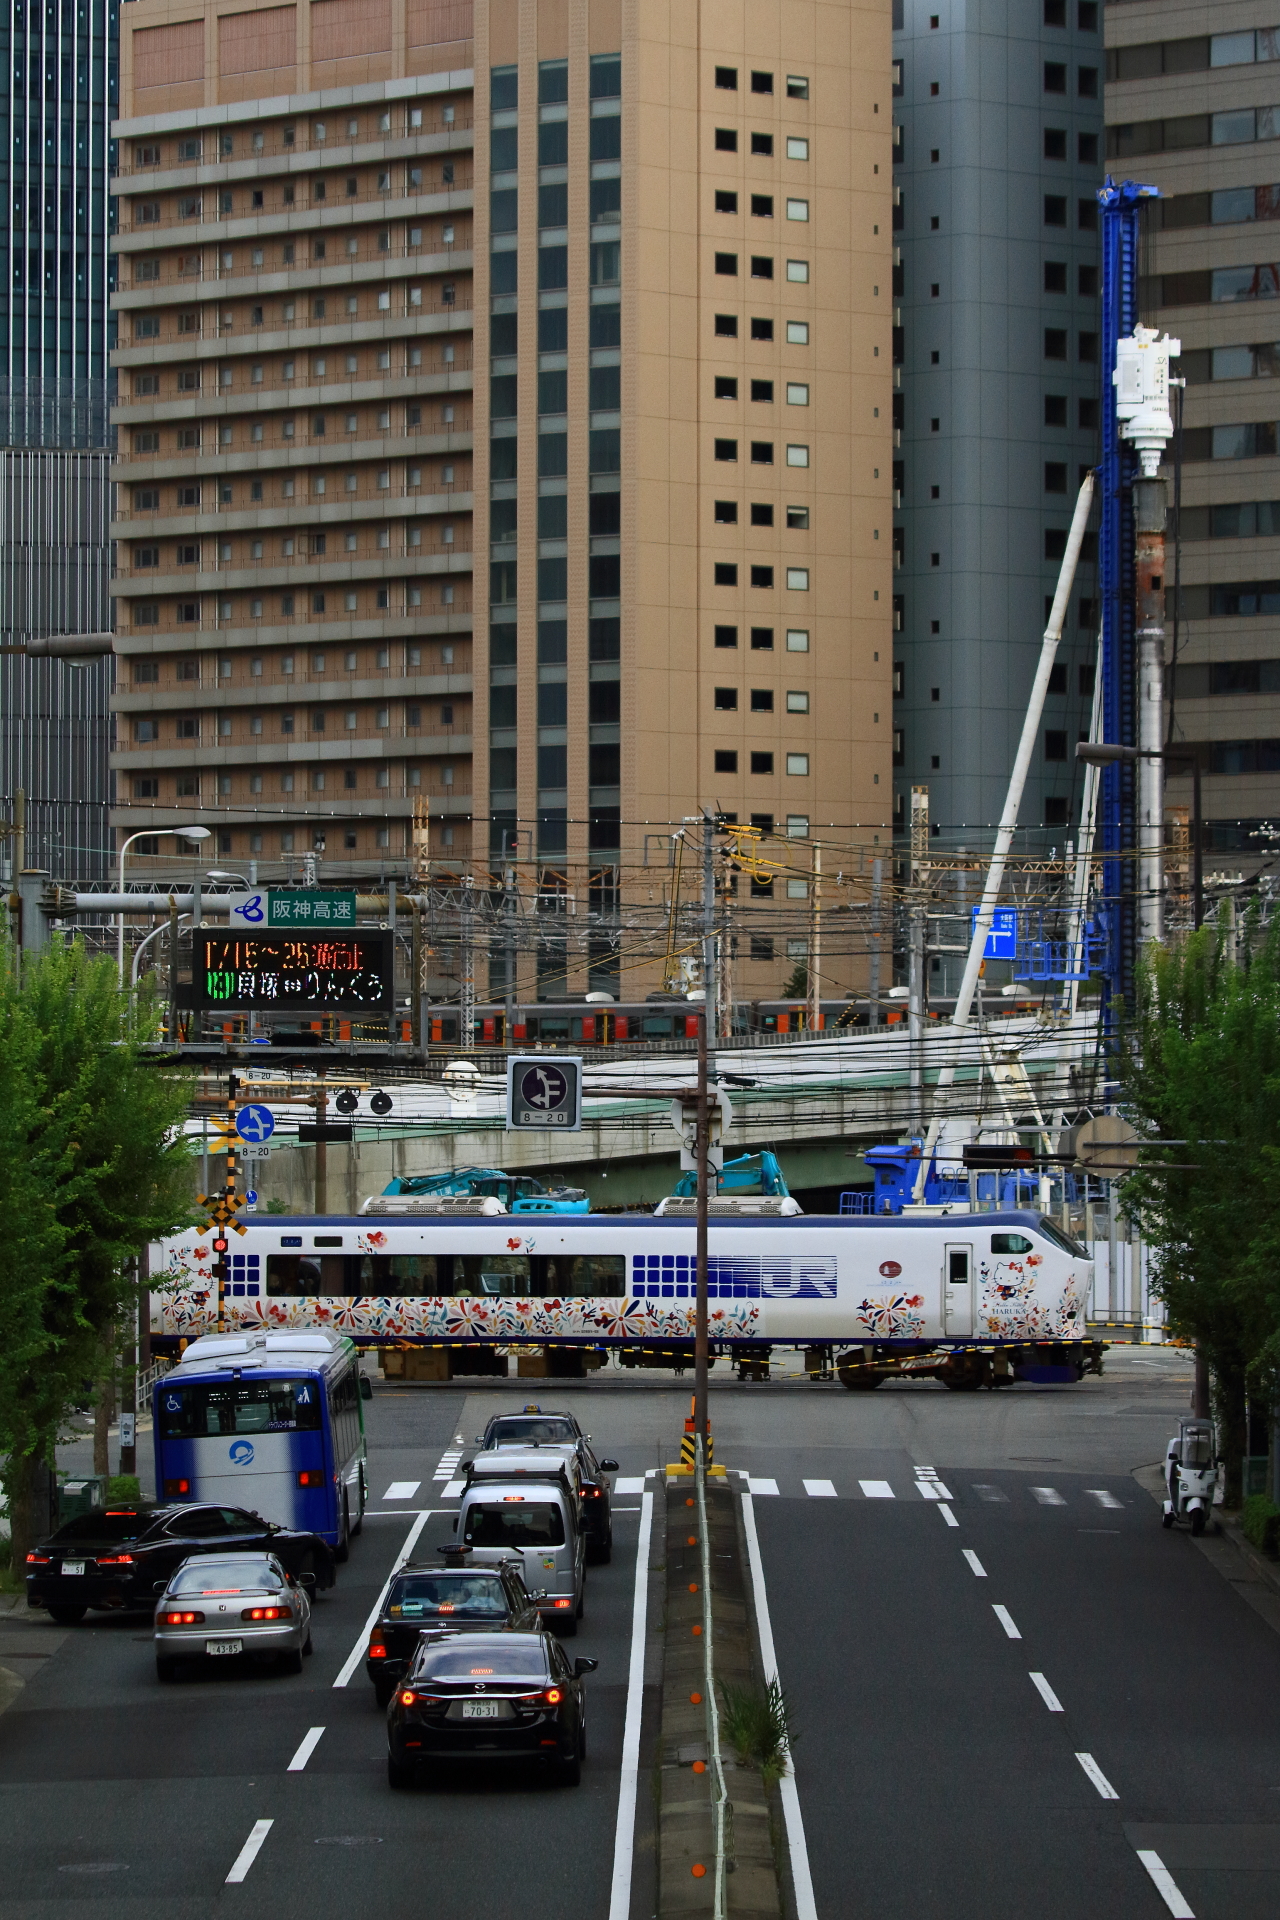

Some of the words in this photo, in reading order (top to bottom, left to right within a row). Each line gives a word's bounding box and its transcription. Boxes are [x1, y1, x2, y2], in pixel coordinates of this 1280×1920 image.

[272, 900, 351, 919] 阪神高速
[217, 1644, 238, 1653] 43-85
[471, 1706, 495, 1716] 70-31
